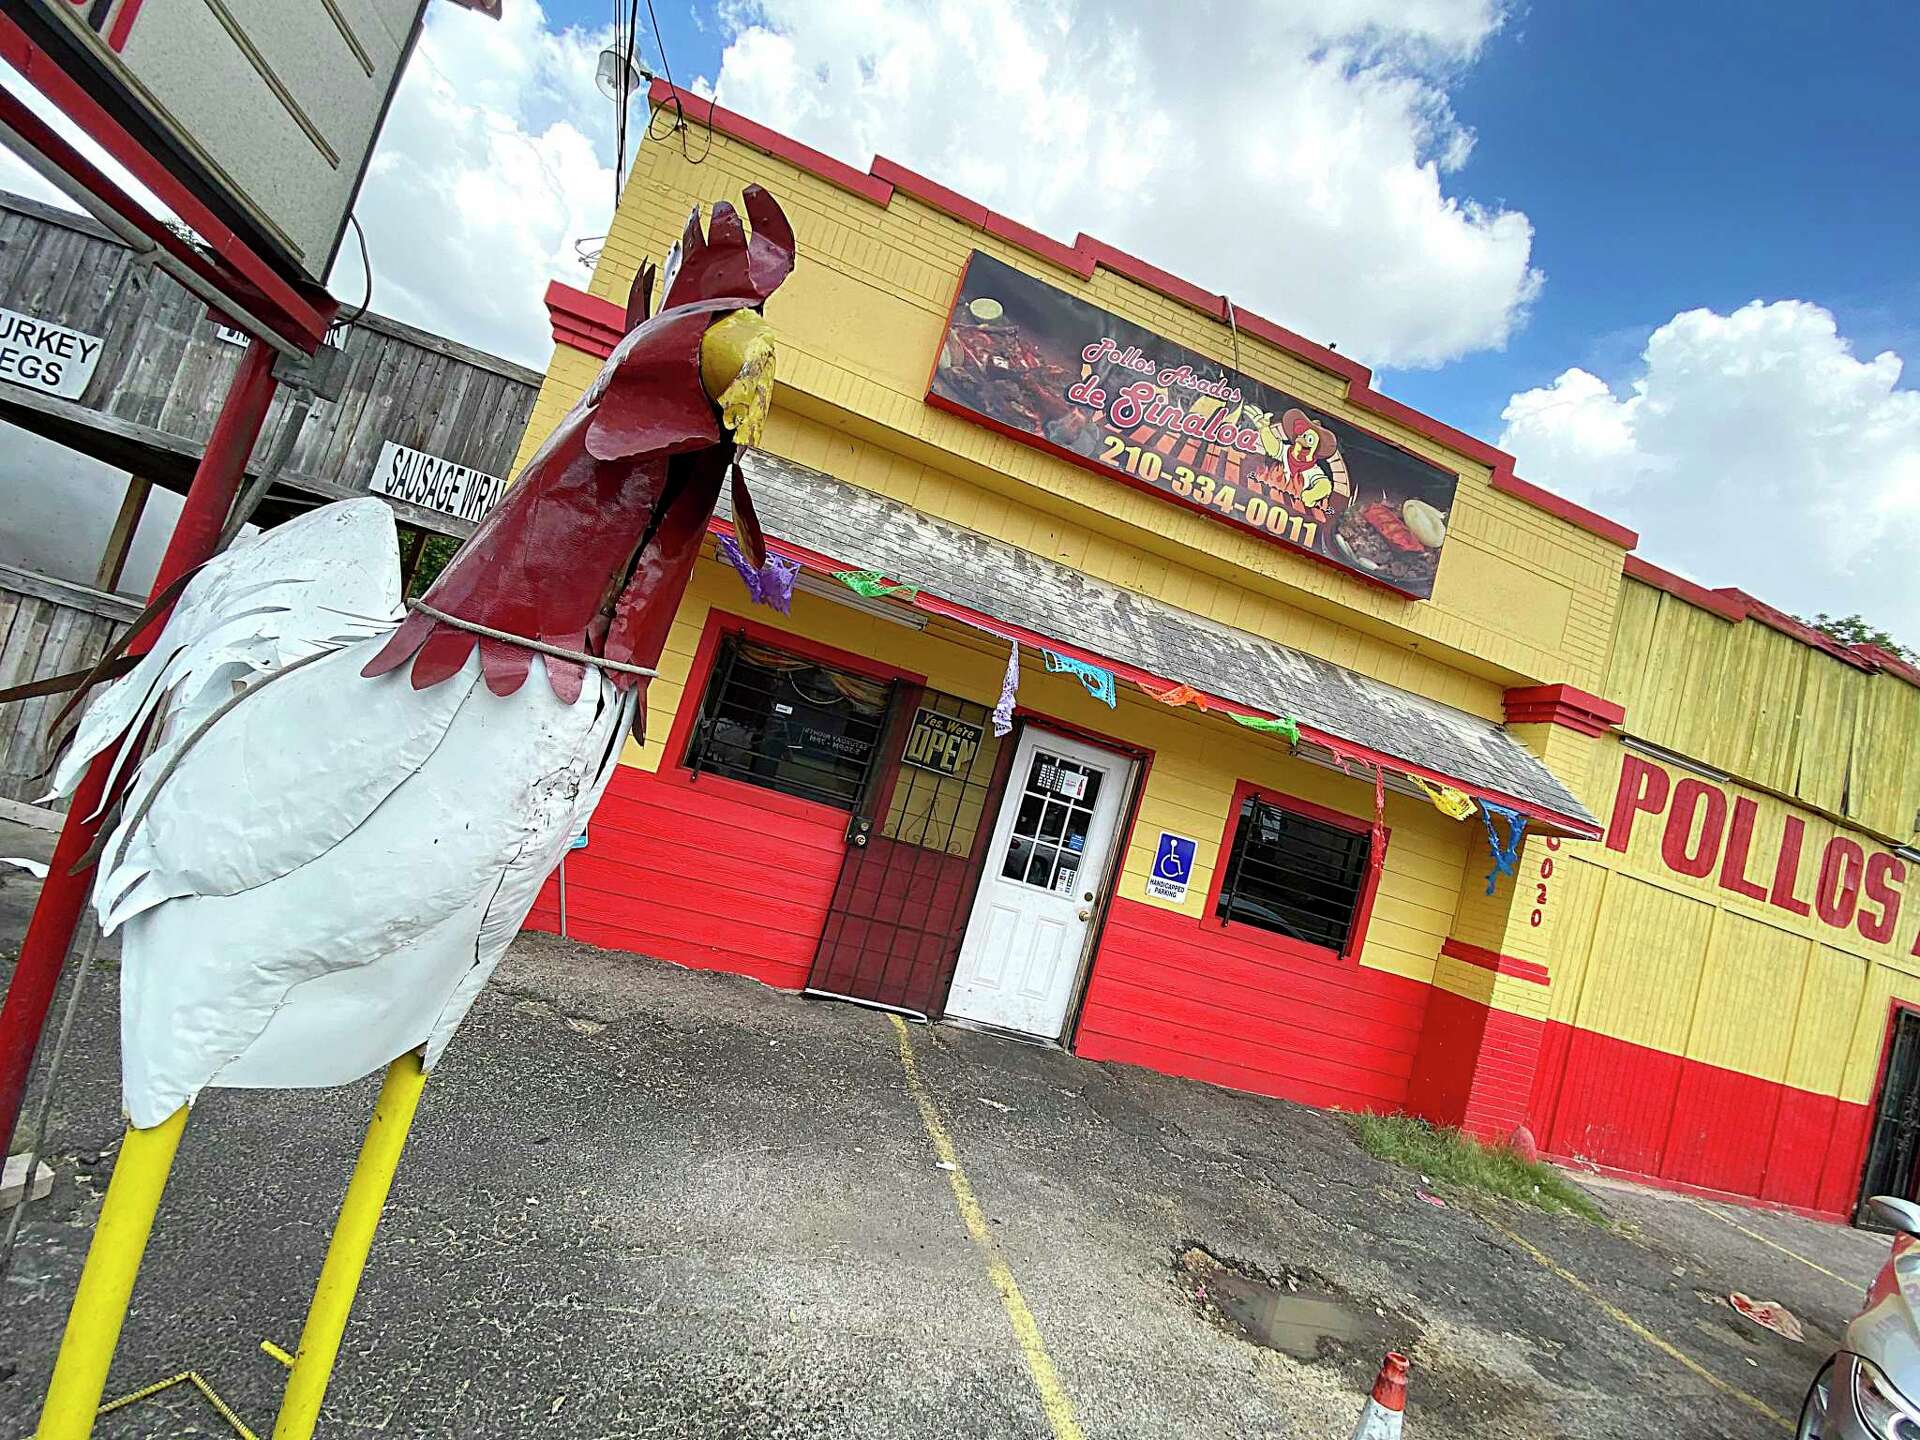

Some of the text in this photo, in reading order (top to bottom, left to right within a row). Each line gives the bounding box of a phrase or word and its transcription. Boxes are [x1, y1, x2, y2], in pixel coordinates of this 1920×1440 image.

[0, 347, 63, 386] EGS
[1082, 337, 1242, 403] Pollos Asados
[1067, 374, 1261, 453] de Sinaloa
[385, 447, 507, 521] SAUSAGE WRA
[1099, 435, 1318, 548] 210-334-0011
[907, 723, 977, 772] OPEN
[946, 721, 975, 740] We're
[1605, 752, 1907, 945] POLLOS
[1149, 878, 1185, 894] HANDICAPPED
[1154, 886, 1177, 898] PARKING
